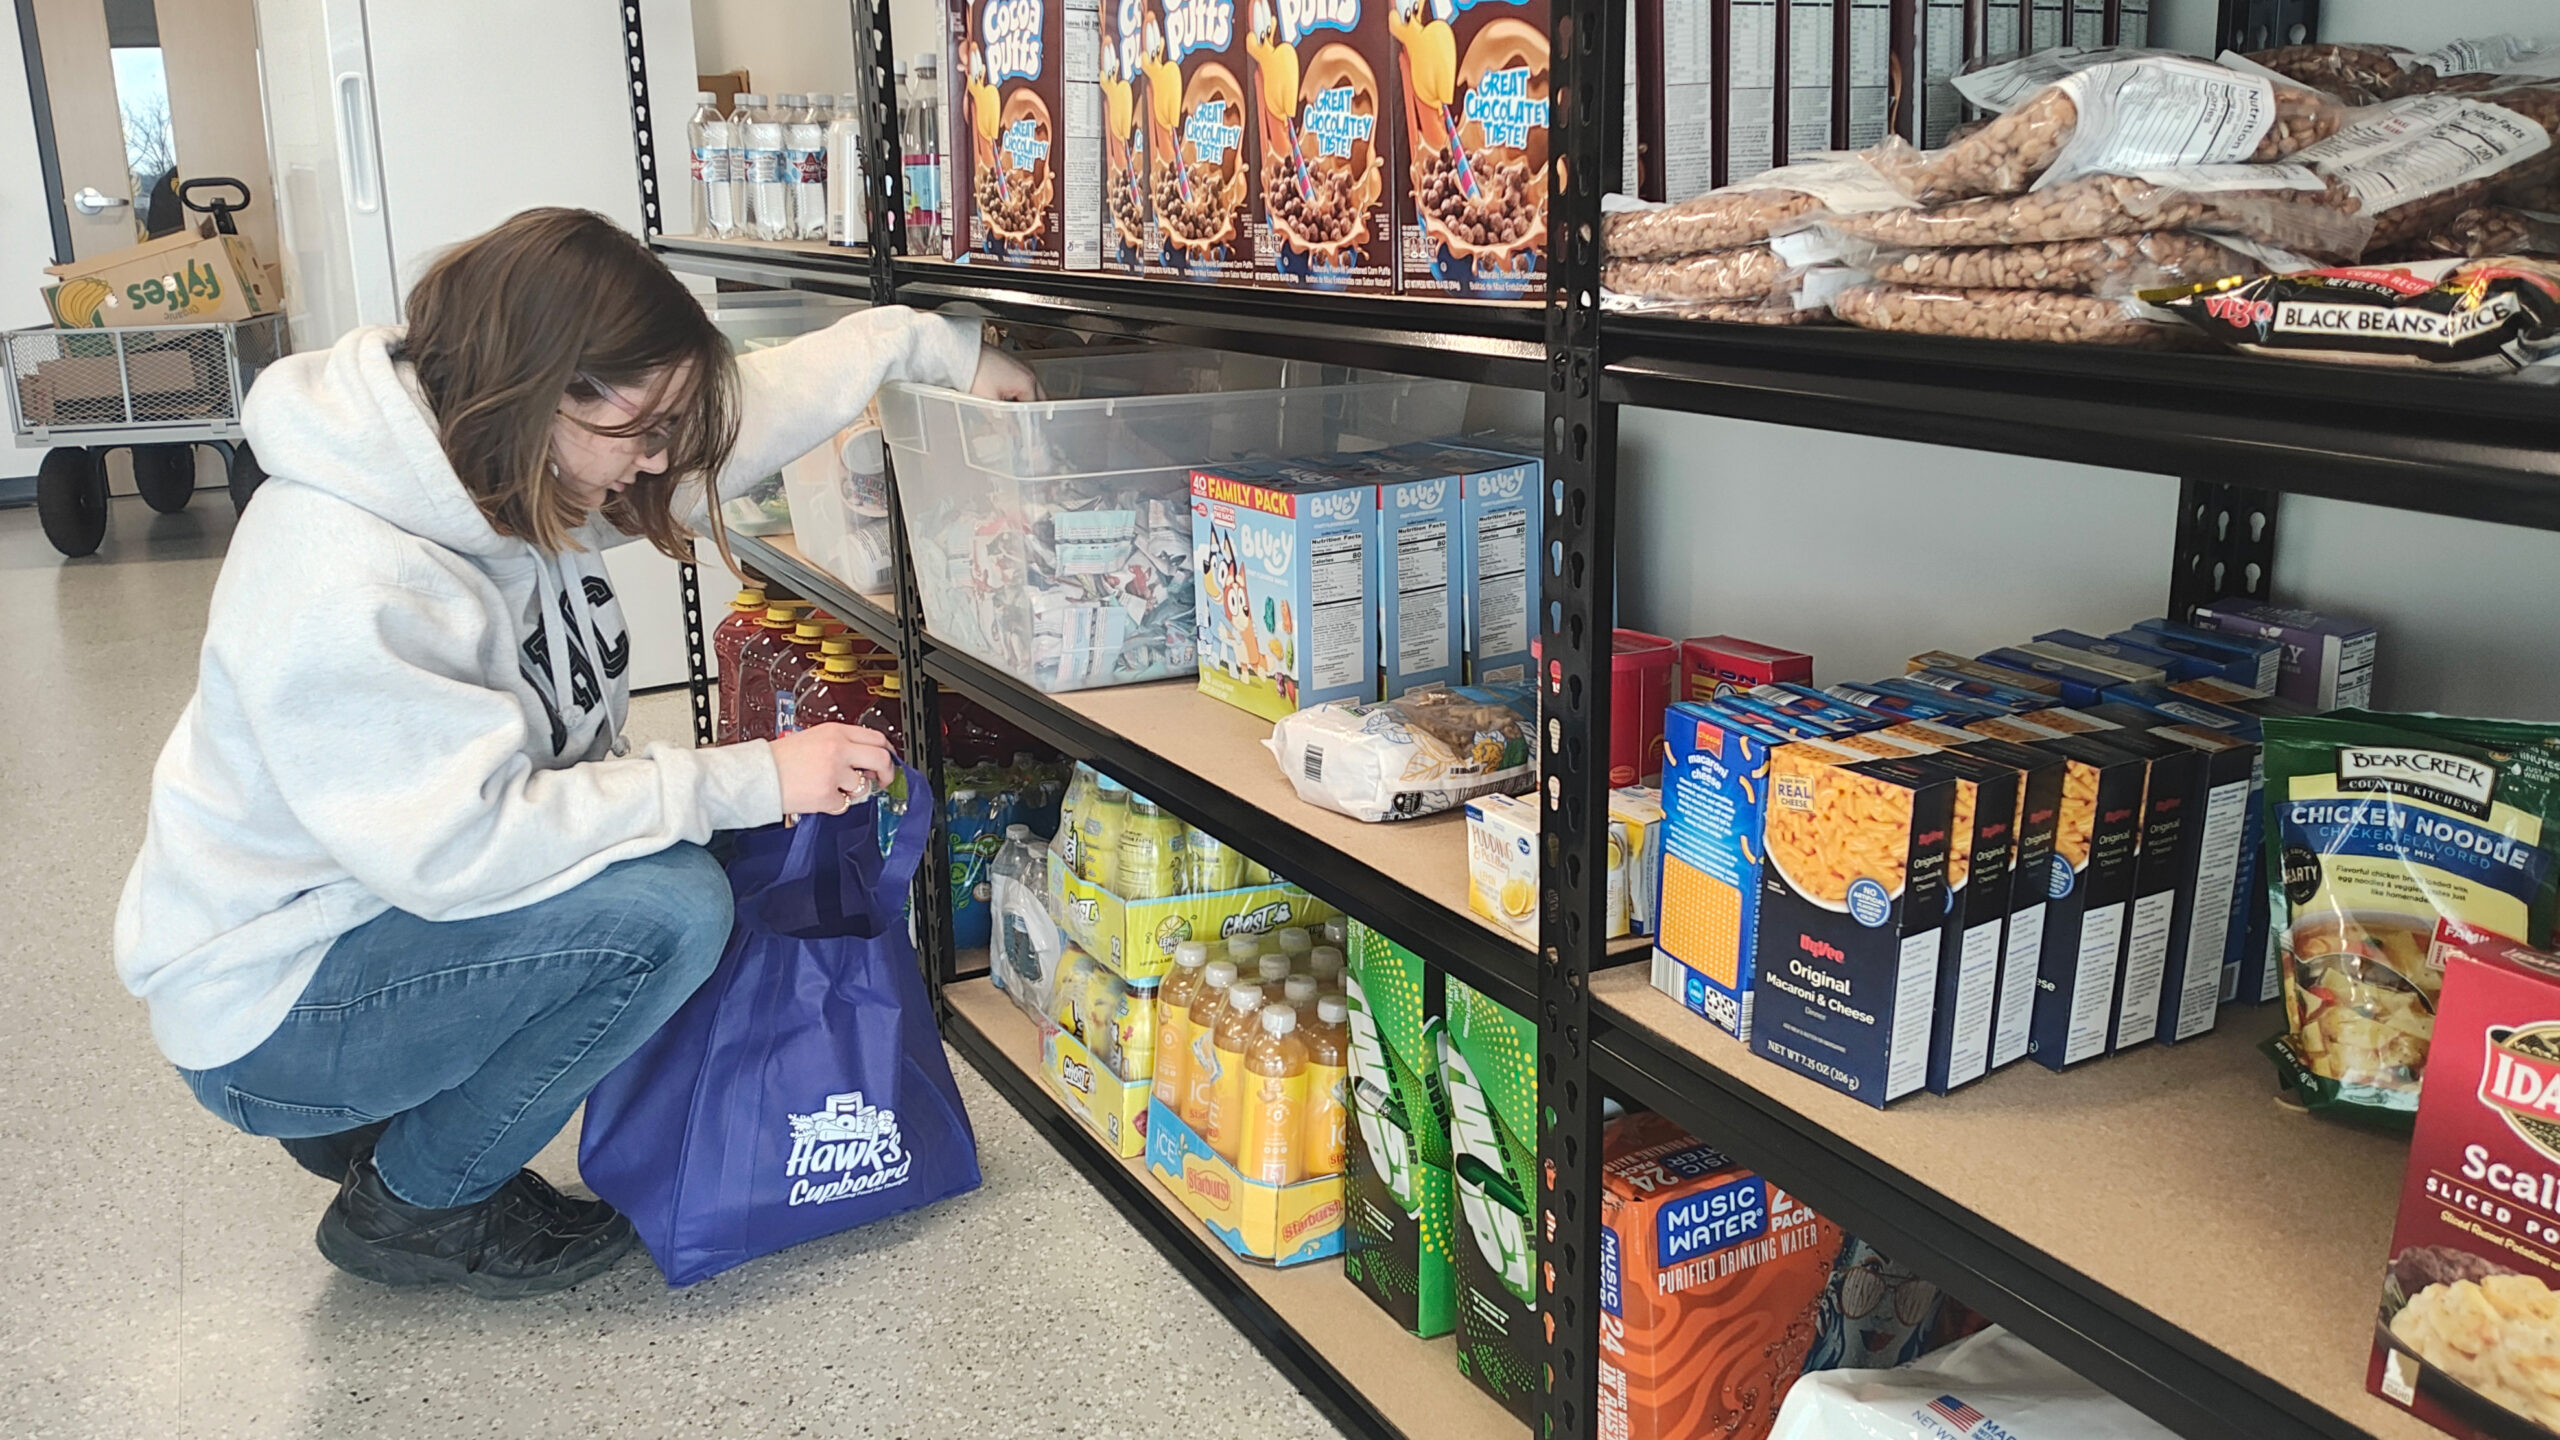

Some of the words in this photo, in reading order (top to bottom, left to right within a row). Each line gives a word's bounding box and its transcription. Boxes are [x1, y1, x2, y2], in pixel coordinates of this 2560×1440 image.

[983, 0, 1041, 43] Cocoa
[1479, 68, 1529, 97] GREAT
[1194, 102, 1225, 123] GREAT
[1315, 88, 1354, 112] GREAT
[1010, 120, 1036, 138] GREAT
[2231, 89, 2259, 149] Nutrition
[2471, 143, 2494, 162] 120
[2284, 310, 2351, 330] BLACK
[2357, 311, 2436, 334] BEANS
[2458, 300, 2511, 332] RICE
[1193, 474, 1207, 492] 40
[1208, 477, 1251, 508] FAMILY
[1254, 488, 1290, 517] PACK
[1396, 479, 1446, 510] BLUEY
[1477, 469, 1526, 498] BLUEY
[1309, 490, 1362, 521] BLUEY
[1516, 527, 1526, 535] 80
[1241, 523, 1294, 577] BLUEY
[1352, 551, 1362, 560] 80
[1688, 754, 1730, 779] macaroni
[1691, 769, 1722, 790] cheese
[2353, 751, 2413, 773] BEAR
[2412, 753, 2485, 789] CREEK
[1777, 783, 1812, 800] REAL
[1781, 797, 1808, 809] CHEESE
[2349, 779, 2409, 796] COUNTRY
[2413, 786, 2479, 814] KITCHENS
[2290, 806, 2407, 831] CHICKEN
[2416, 815, 2530, 871] NOODLE
[2402, 834, 2491, 871] FLAVORED
[2414, 848, 2436, 862] MIX
[1110, 935, 1122, 958] 12
[1789, 959, 1852, 996] Original
[1766, 971, 1816, 1003] Macaroni
[1816, 993, 1827, 1007] &
[1828, 998, 1876, 1026] Cheese
[1767, 1039, 1786, 1056] NET
[1786, 1048, 1801, 1063] WT
[1815, 1061, 1831, 1076] OZ
[2490, 1051, 2560, 1115] IDA
[1108, 1112, 1119, 1135] 12
[785, 1122, 902, 1177] Hawk's
[788, 1149, 912, 1207] Cupboard
[1187, 1167, 1230, 1202] Starburst
[1627, 1166, 1679, 1193] 24
[1282, 1199, 1341, 1242] Starburst
[1667, 1186, 1756, 1232] MUSIC
[1771, 1207, 1815, 1233] PACK
[2425, 1176, 2512, 1224] SLICED
[2525, 1219, 2560, 1245] PO
[1604, 1235, 1618, 1309] MUSIC
[1658, 1258, 1716, 1296] PURIFIED
[1720, 1237, 1777, 1277] DRINKING
[1780, 1223, 1818, 1257] WATER
[1601, 1311, 1625, 1357] 24
[1911, 1409, 1938, 1430] NET
